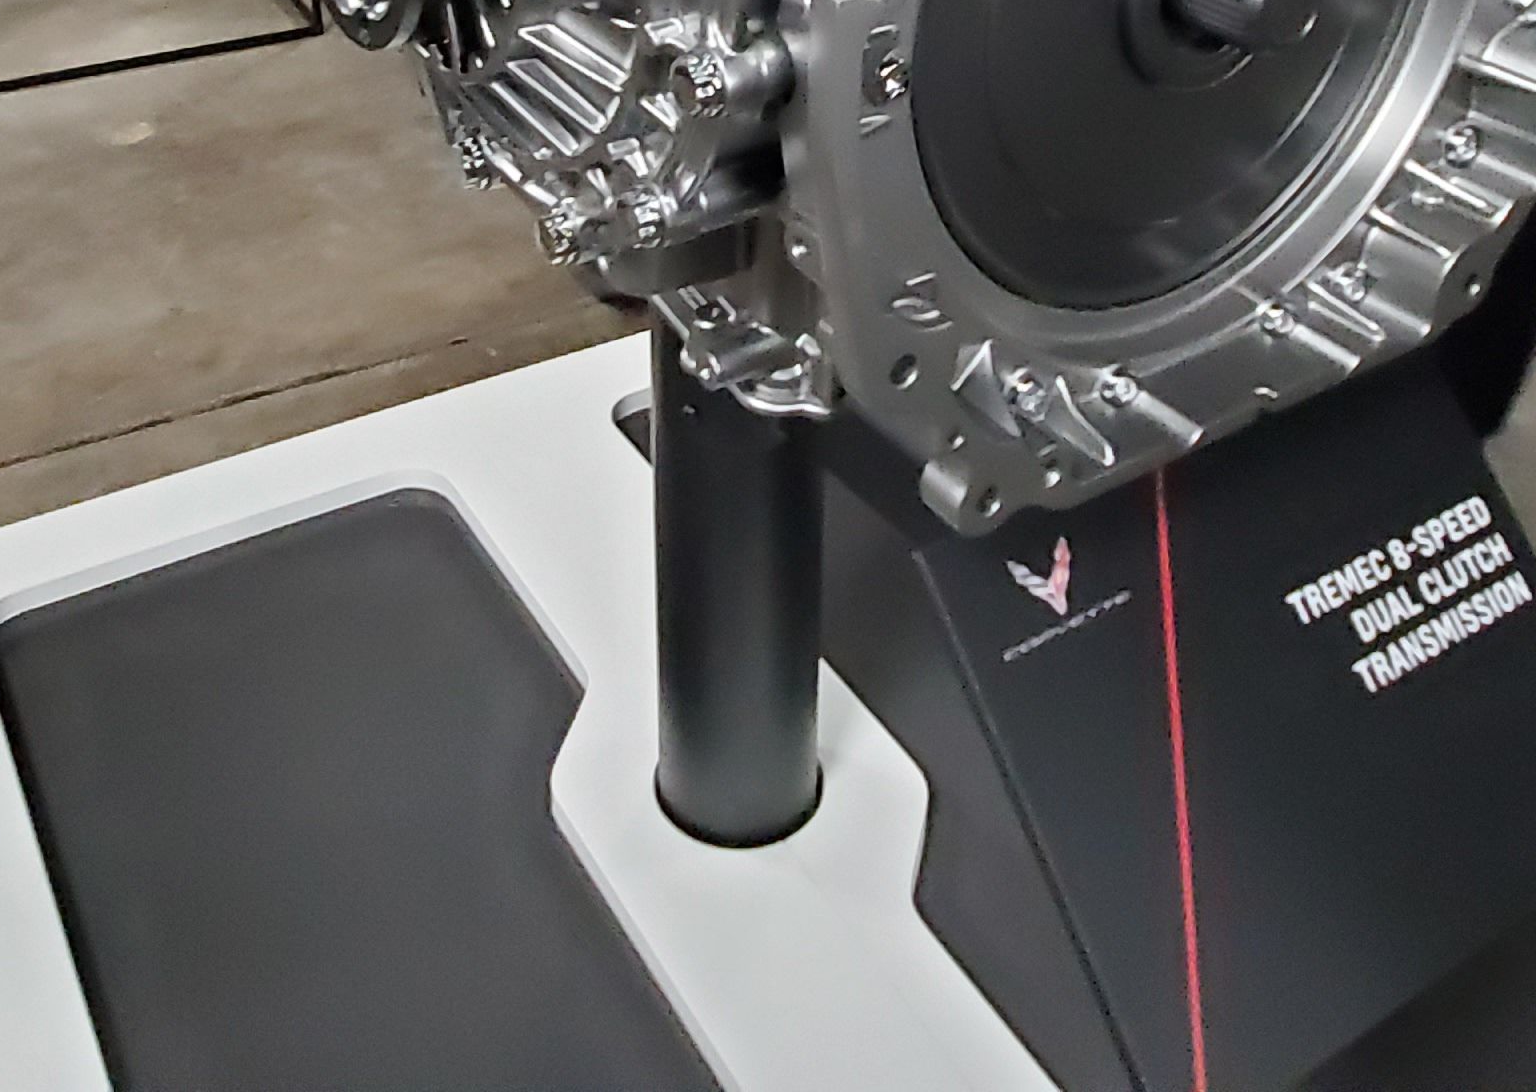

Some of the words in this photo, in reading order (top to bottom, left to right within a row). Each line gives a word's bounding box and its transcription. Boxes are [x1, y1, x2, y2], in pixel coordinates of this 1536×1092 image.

[1284, 549, 1393, 625] TREMEC
[1386, 495, 1493, 572] 8-SPEED
[1350, 585, 1425, 643] DUAL
[1417, 531, 1515, 605] CLUTCH
[1351, 570, 1533, 693] TRANSMISSION
